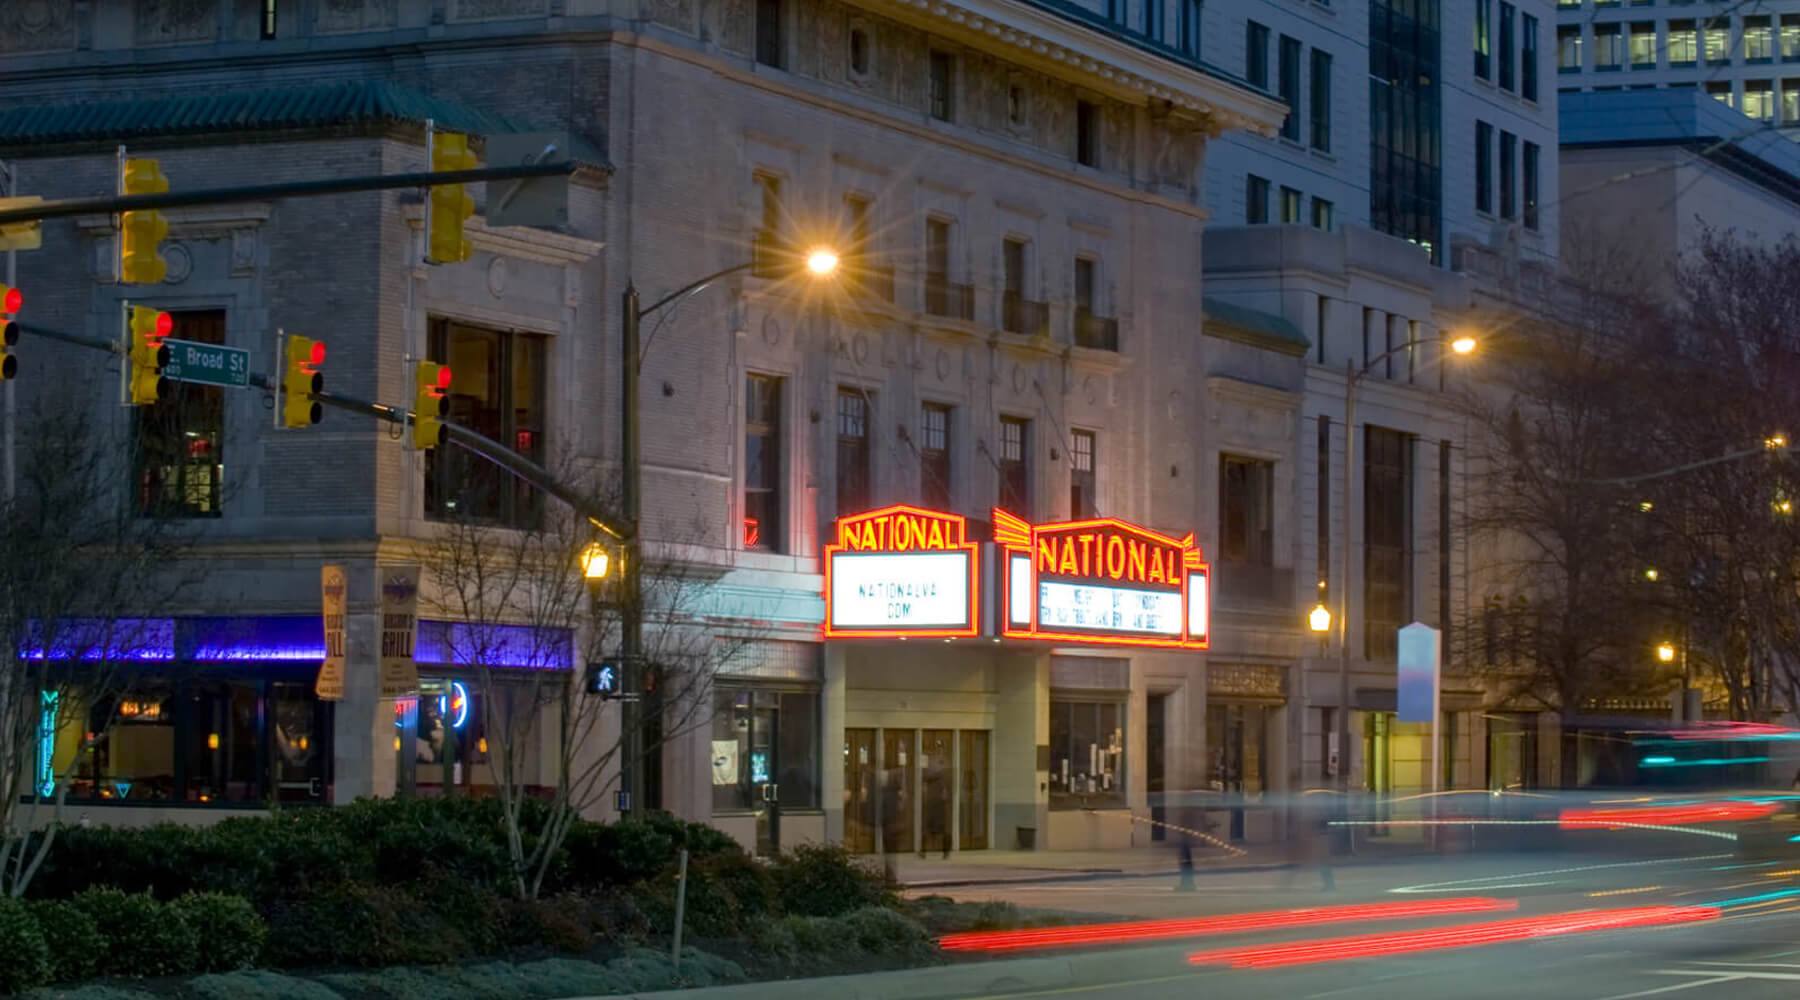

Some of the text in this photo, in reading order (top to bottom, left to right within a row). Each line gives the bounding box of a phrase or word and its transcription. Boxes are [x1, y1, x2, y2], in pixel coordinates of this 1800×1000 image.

[186, 347, 224, 369] Broad
[230, 353, 244, 372] St
[843, 515, 959, 552] NATIONAL
[1037, 535, 1181, 585] NATIONAL
[382, 631, 413, 658] GRILL
